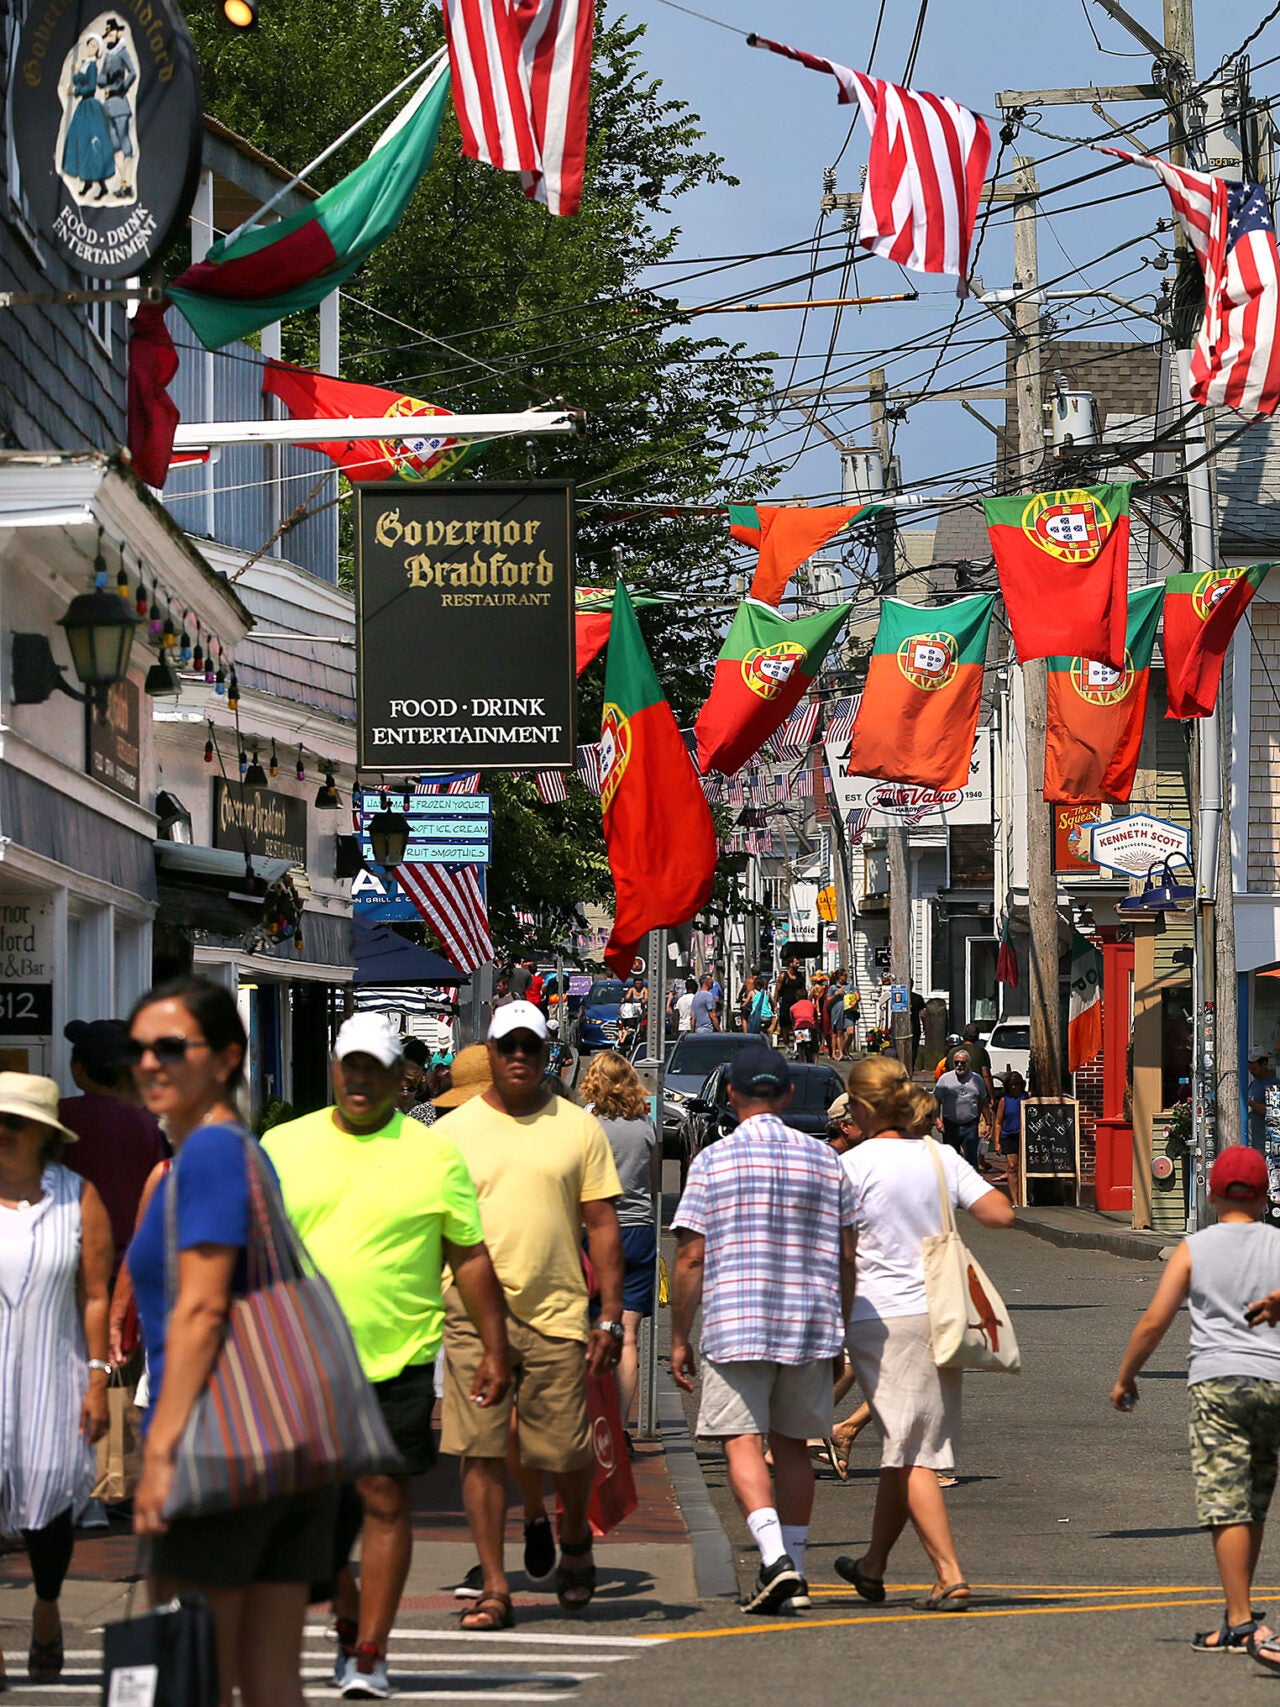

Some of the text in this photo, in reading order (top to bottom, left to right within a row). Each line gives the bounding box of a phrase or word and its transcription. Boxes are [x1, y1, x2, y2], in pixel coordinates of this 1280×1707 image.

[59, 203, 150, 247] FOOD DRINK
[52, 215, 158, 265] ENTERTAINMENT
[374, 507, 542, 548] Governor
[404, 550, 554, 588] Bradford
[441, 594, 551, 607] RESTAURANT
[389, 699, 546, 717] FOOD DRINK
[372, 726, 561, 745] ENTERTAINMENT
[416, 800, 451, 809] FROZEN
[453, 800, 486, 809] YOGURT
[908, 787, 958, 805] Value
[1071, 806, 1088, 815] The
[435, 825, 452, 833] ICE
[453, 825, 487, 834] CREAM
[1099, 830, 1182, 849] KENNETH SCOTT
[430, 848, 485, 858] SMOOTHIES
[792, 925, 815, 934] birdie
